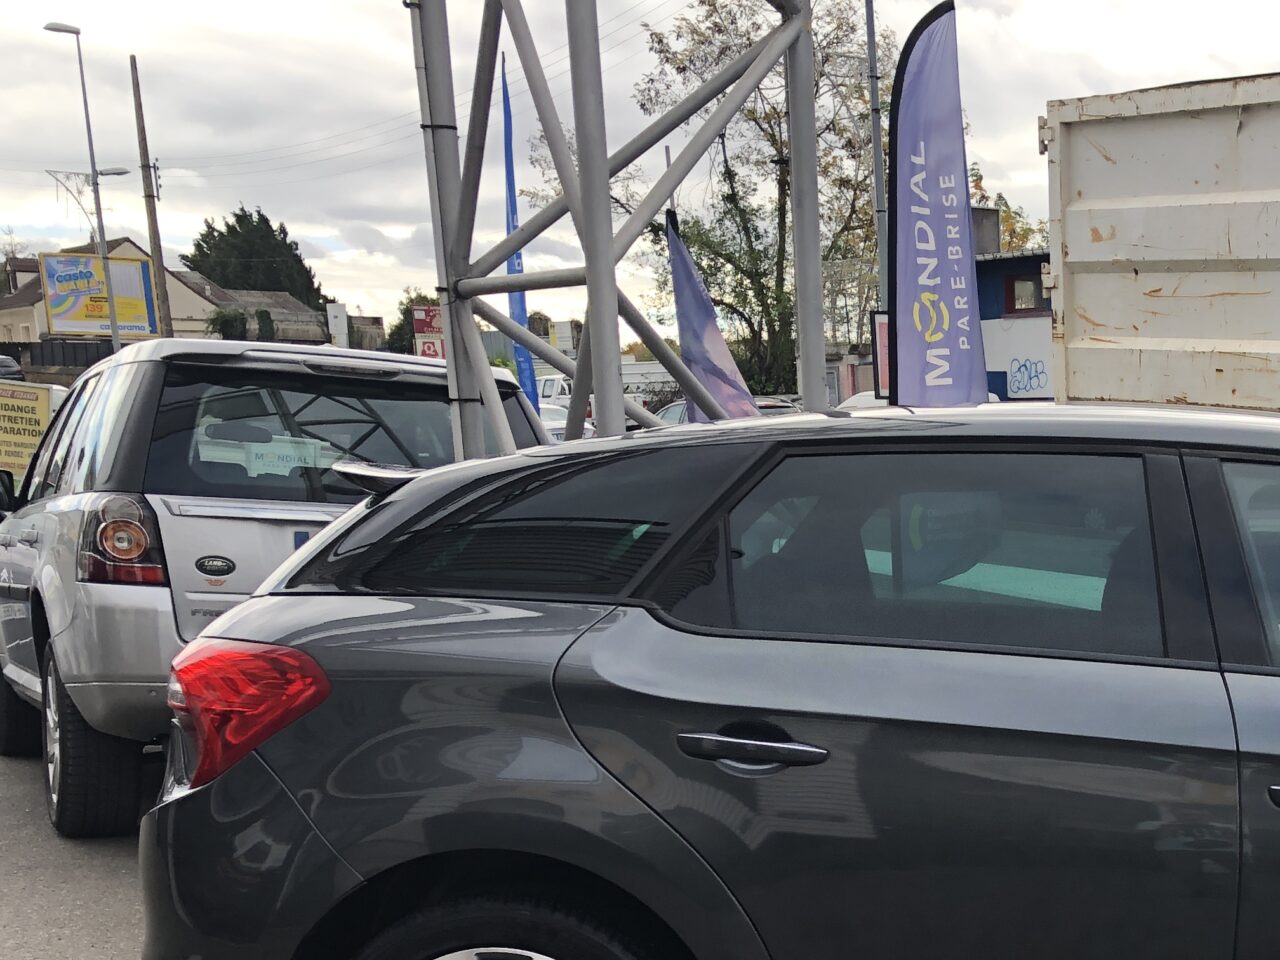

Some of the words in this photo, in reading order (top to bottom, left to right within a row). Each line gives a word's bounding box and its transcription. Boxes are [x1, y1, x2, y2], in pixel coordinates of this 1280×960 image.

[99, 323, 146, 332] caorama
[910, 141, 953, 386] MONDIAL
[939, 174, 971, 350] PARE-BRISE
